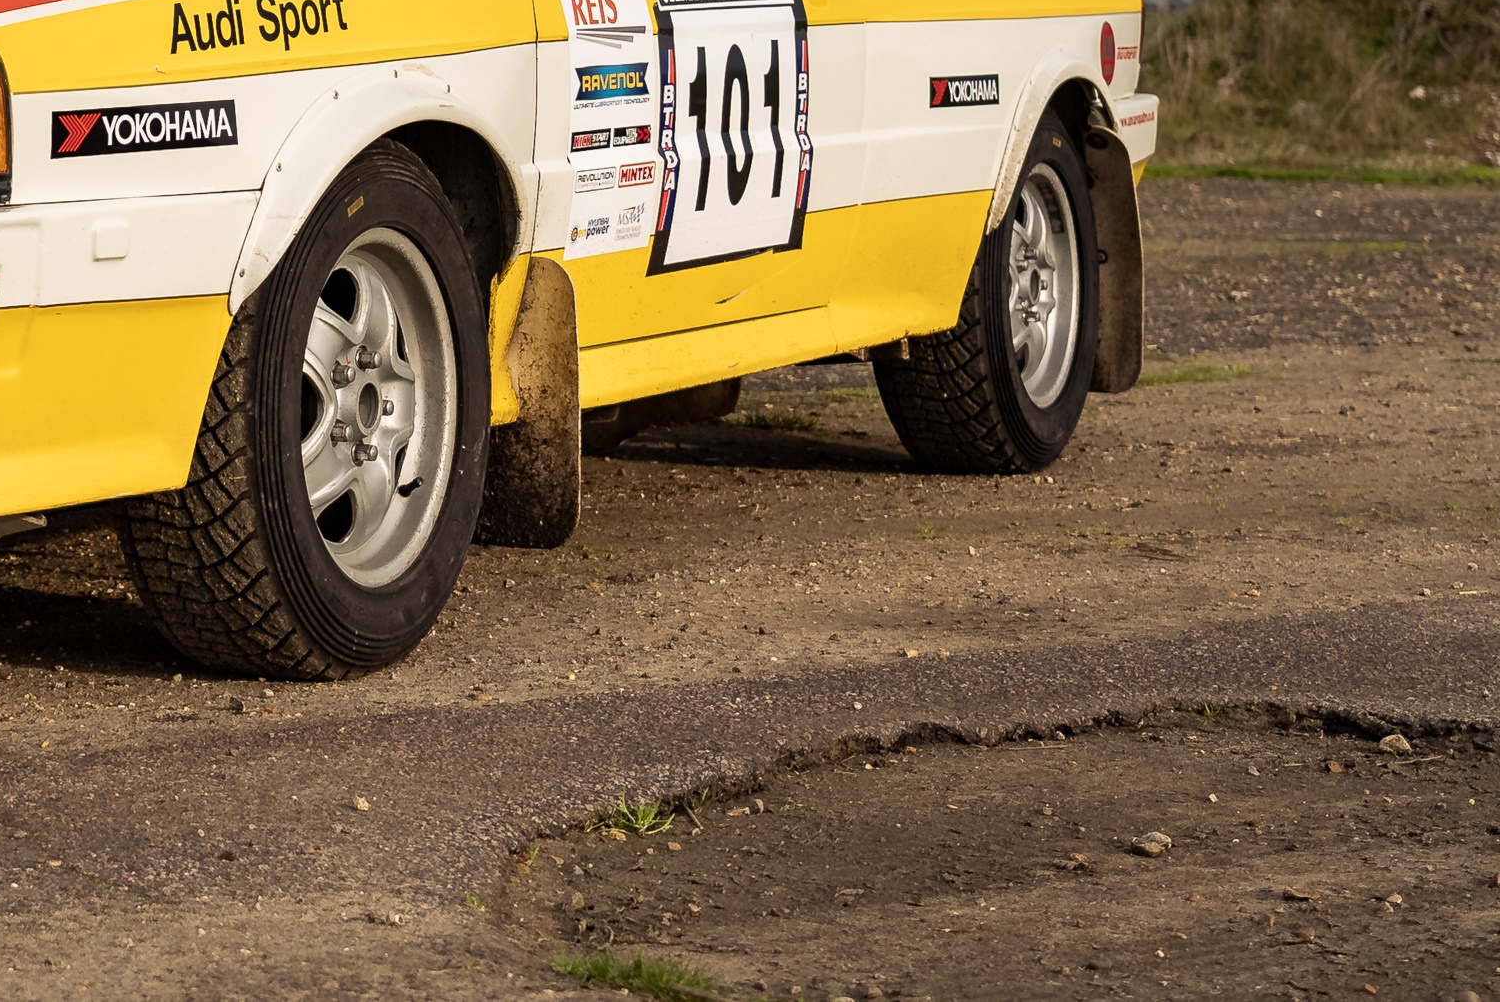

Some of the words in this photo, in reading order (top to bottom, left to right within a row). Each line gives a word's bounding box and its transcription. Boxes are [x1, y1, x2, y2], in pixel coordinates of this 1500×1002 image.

[582, 71, 644, 93] RAVENOL
[947, 79, 998, 103] YOKOHAMA
[101, 106, 234, 147] YOKOHAMA
[661, 84, 679, 191] BTRDA
[688, 38, 785, 212] 101
[796, 72, 811, 171] BTRDA
[577, 171, 615, 183] REVOLUTION
[620, 166, 654, 183] MINTEX
